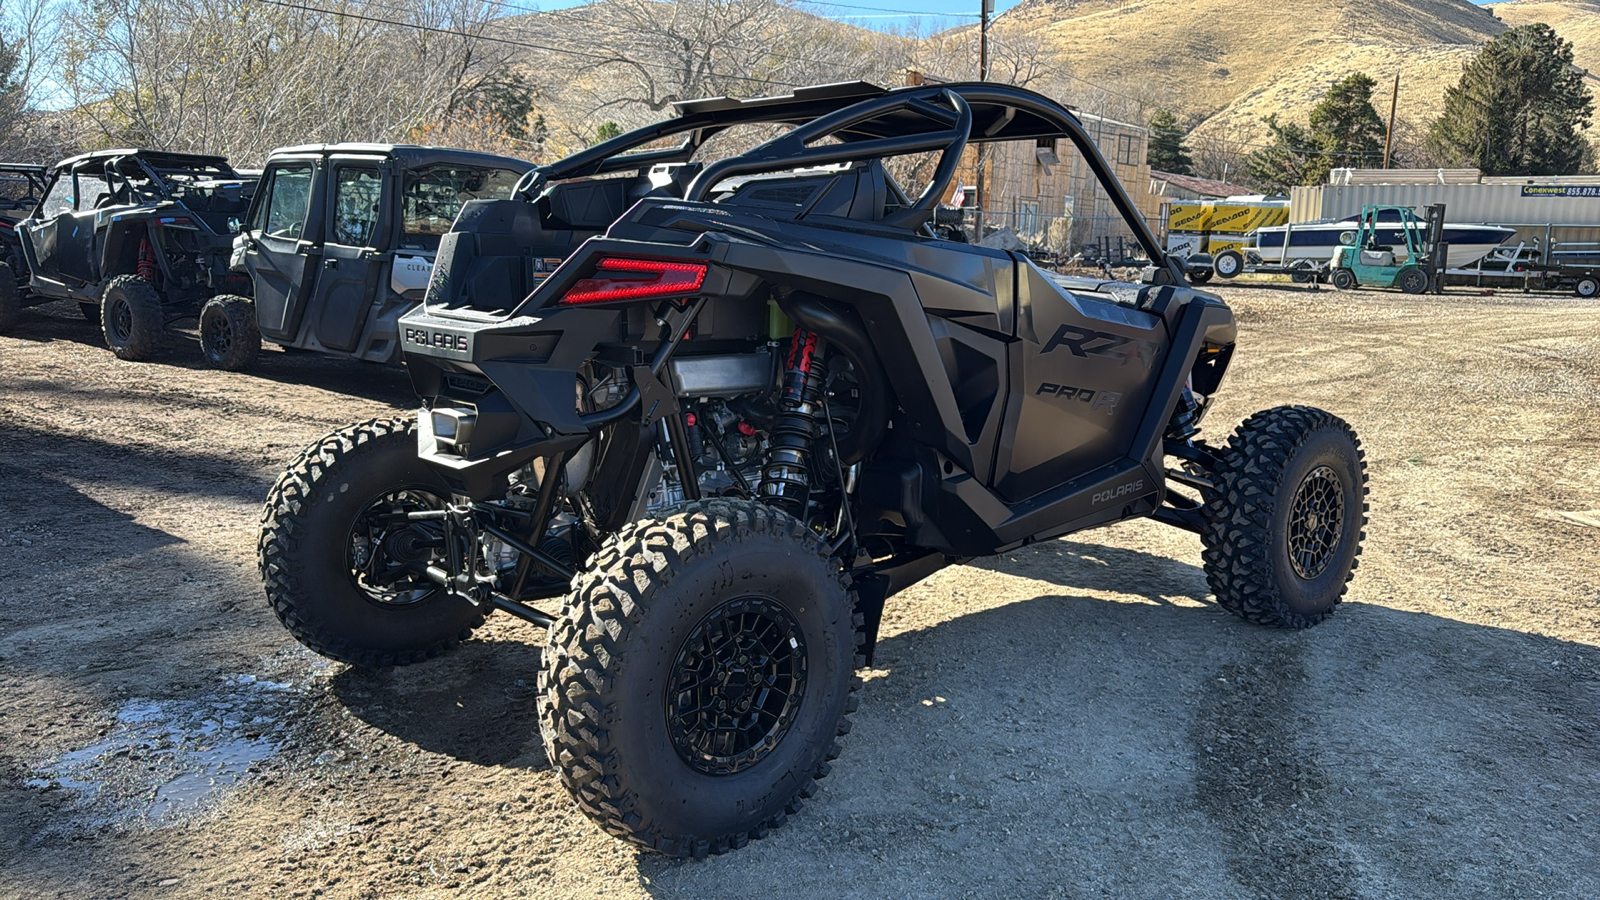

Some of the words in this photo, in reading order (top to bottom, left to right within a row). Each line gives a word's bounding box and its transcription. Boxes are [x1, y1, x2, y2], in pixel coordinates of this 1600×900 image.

[1524, 186, 1566, 194] Conexwest
[405, 327, 468, 351] POLARIS
[1035, 382, 1096, 403] PRO
[1091, 479, 1144, 506] POLARIS
